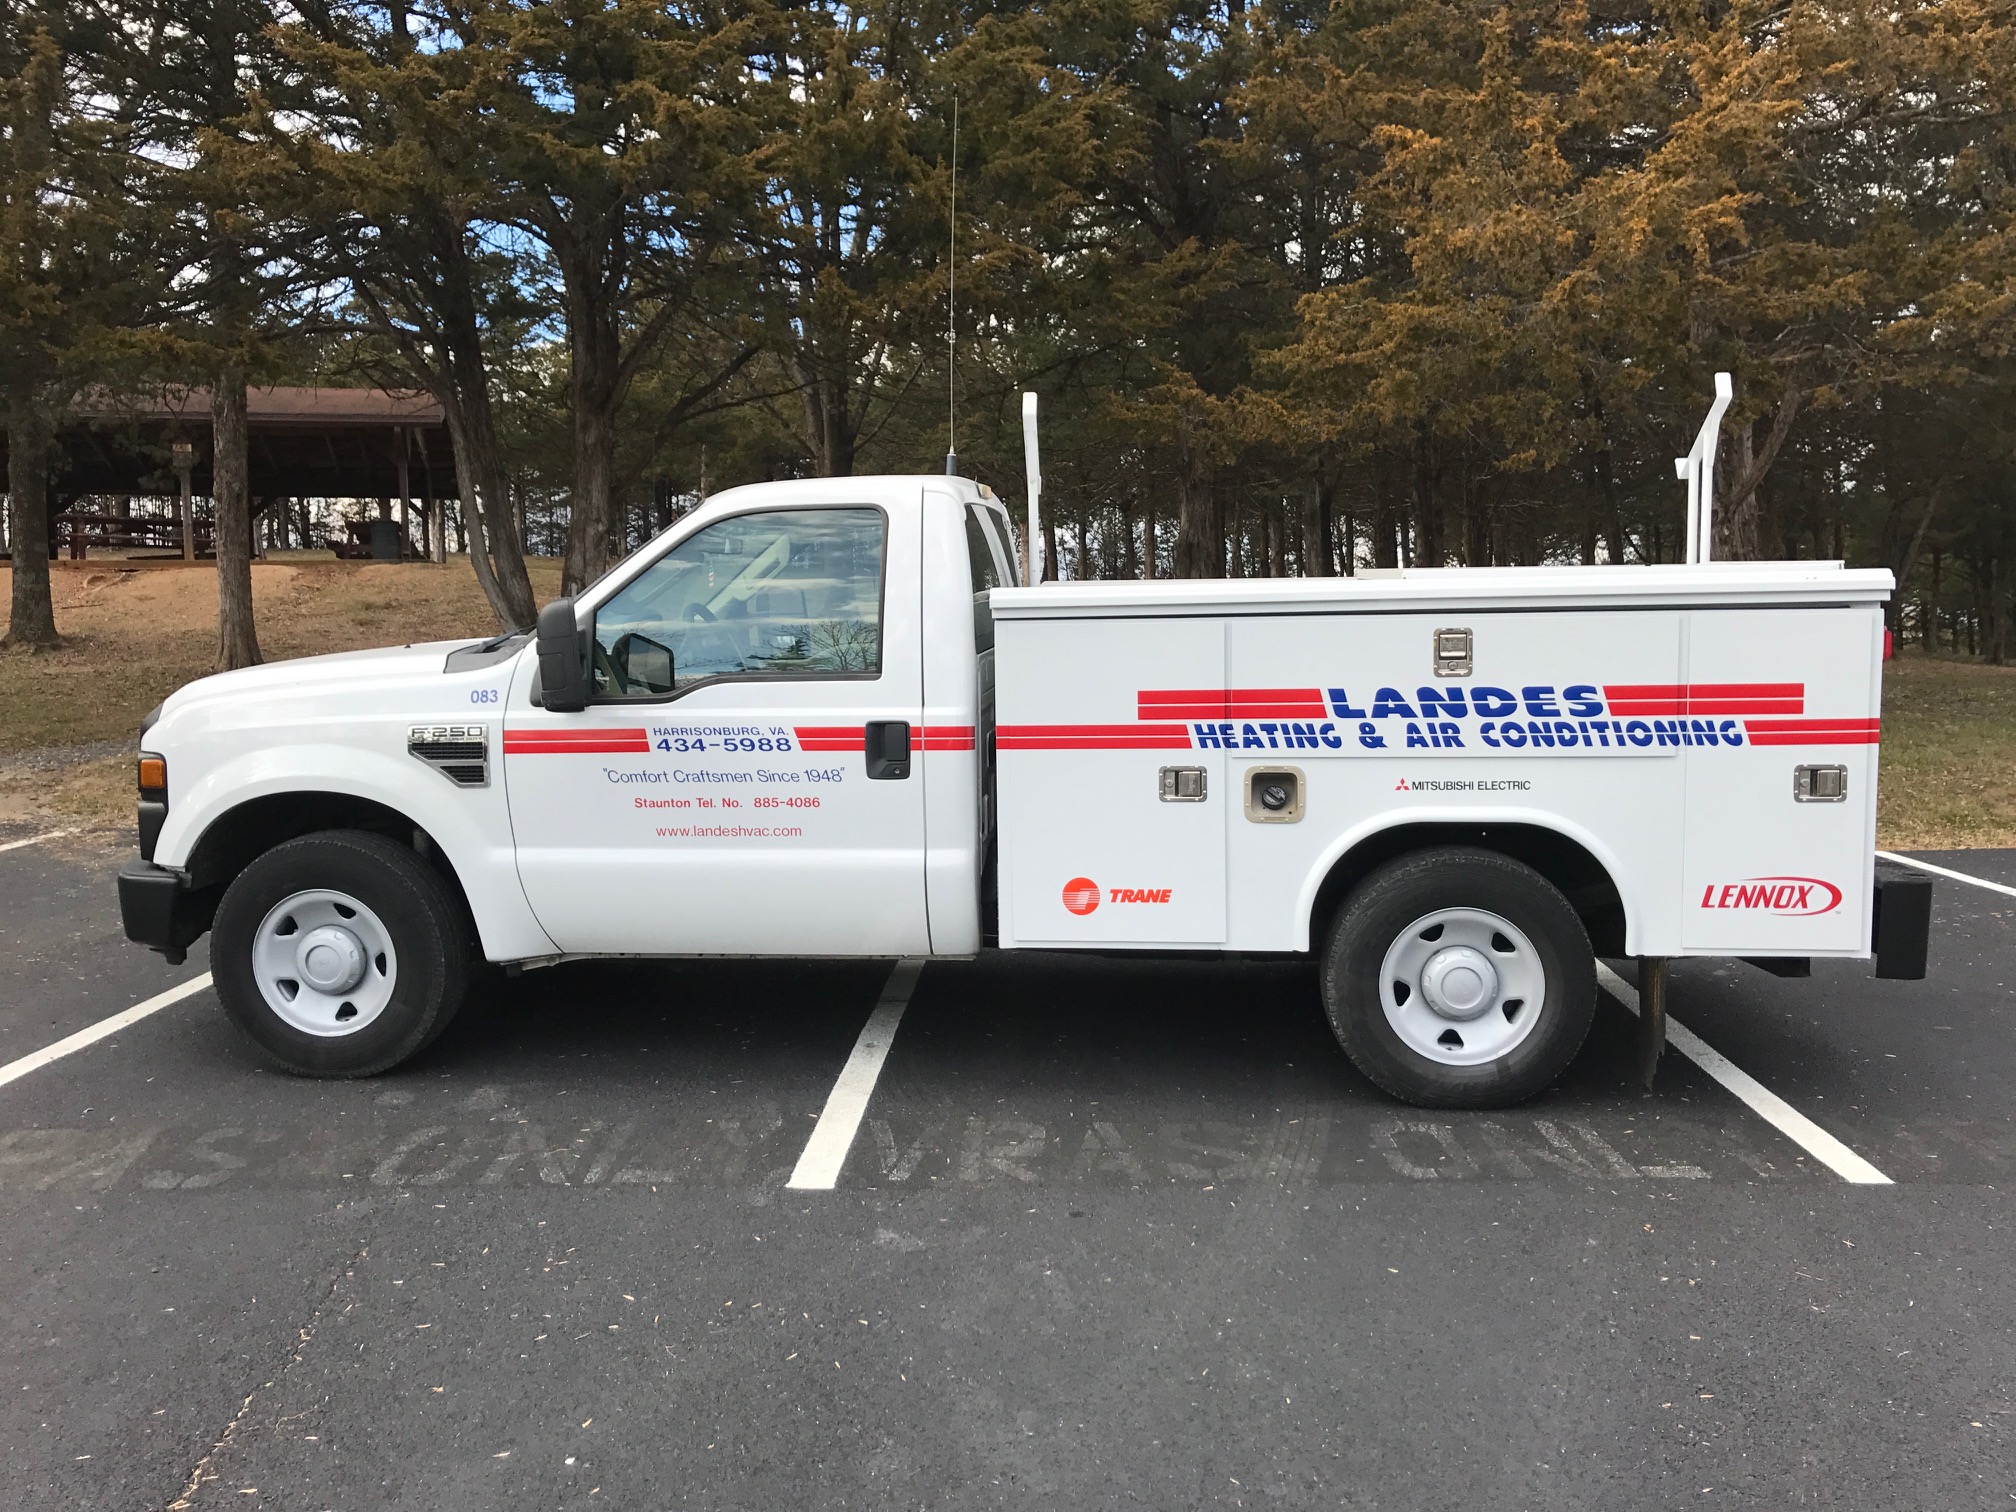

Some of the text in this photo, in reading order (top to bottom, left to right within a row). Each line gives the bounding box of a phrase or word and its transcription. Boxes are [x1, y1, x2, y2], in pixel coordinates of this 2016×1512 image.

[470, 689, 499, 704] 083
[1327, 685, 1604, 719] LANDES
[653, 726, 790, 737] HARRISONBURG, VA.
[1193, 719, 1744, 749] HEATING & AIR CONDITIONING
[656, 737, 792, 752] 434-5988
[602, 767, 845, 783] "Comfort Craftsmen Since 1948"
[1412, 780, 1531, 791] MITSUBISHI ELECTRIC
[634, 797, 821, 809] Staunton Tel. No. 885-4086
[655, 825, 802, 837] www.landeshvac.com
[1109, 888, 1173, 903] TRANE
[1700, 884, 1814, 909] LENNOX
